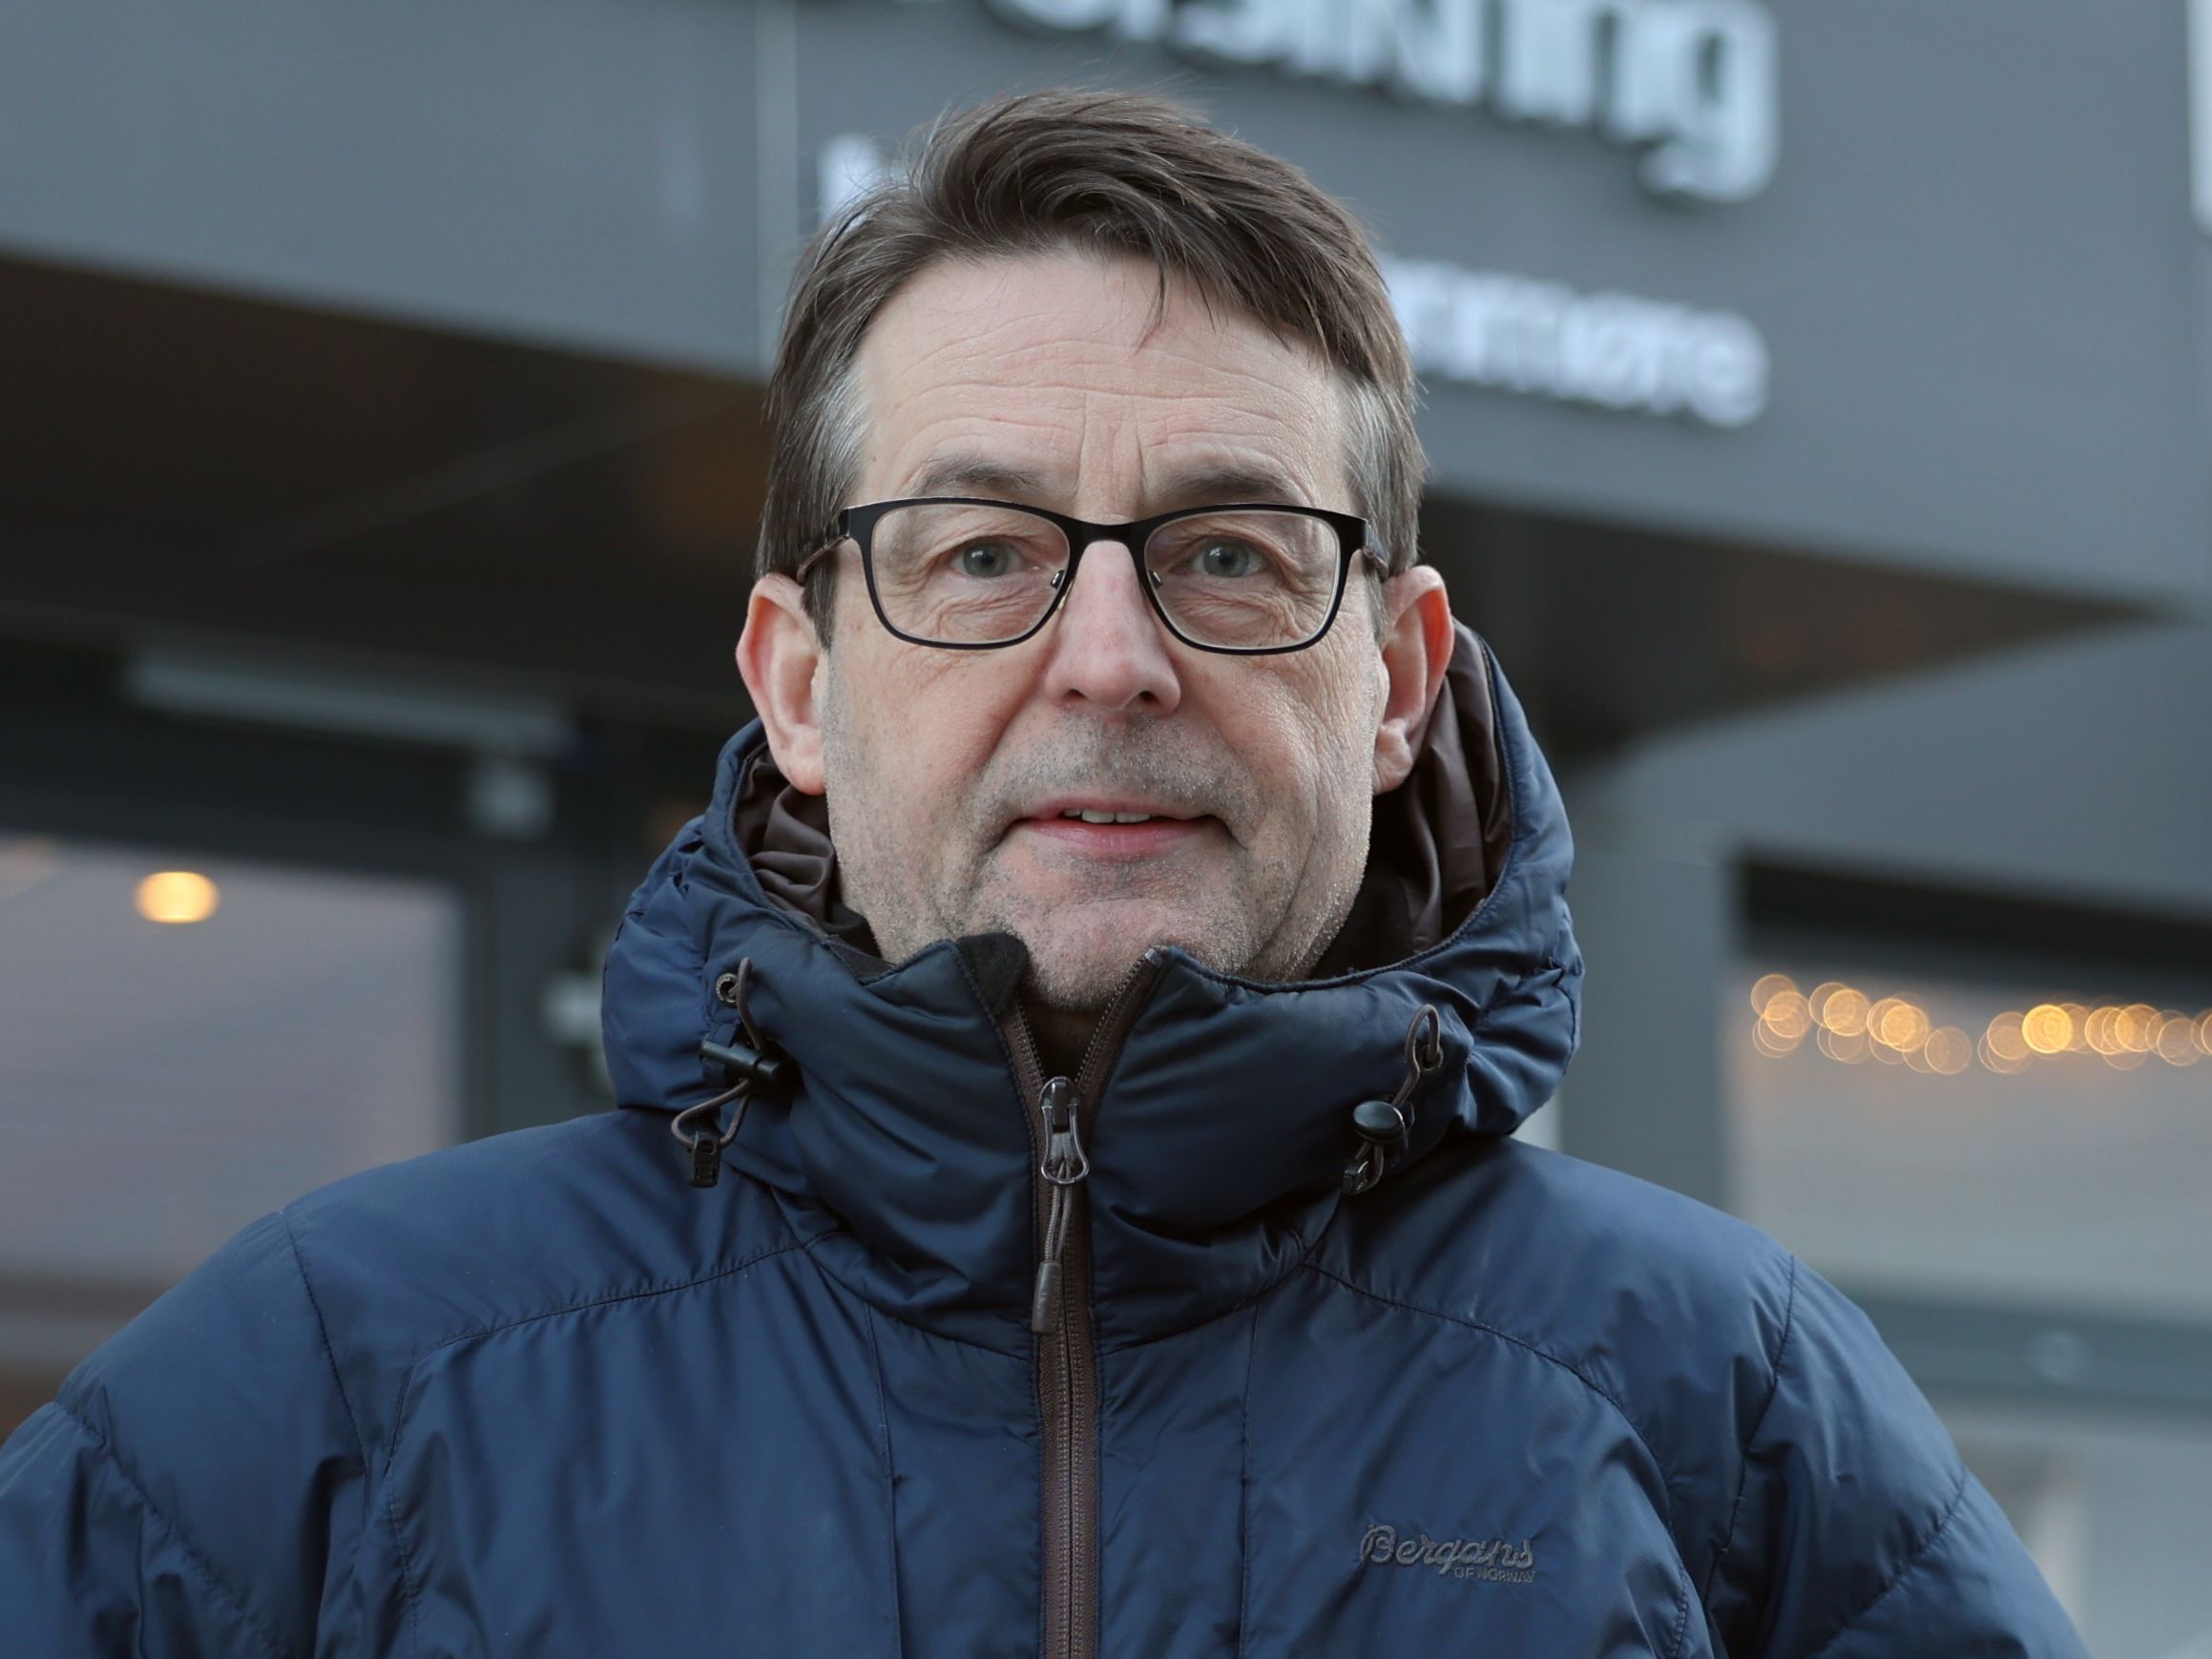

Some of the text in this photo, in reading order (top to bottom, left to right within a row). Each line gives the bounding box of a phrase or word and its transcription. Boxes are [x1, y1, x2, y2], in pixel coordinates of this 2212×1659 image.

[1359, 1524, 1535, 1574] Bergans
[1454, 1566, 1536, 1584] OF NORWAY
